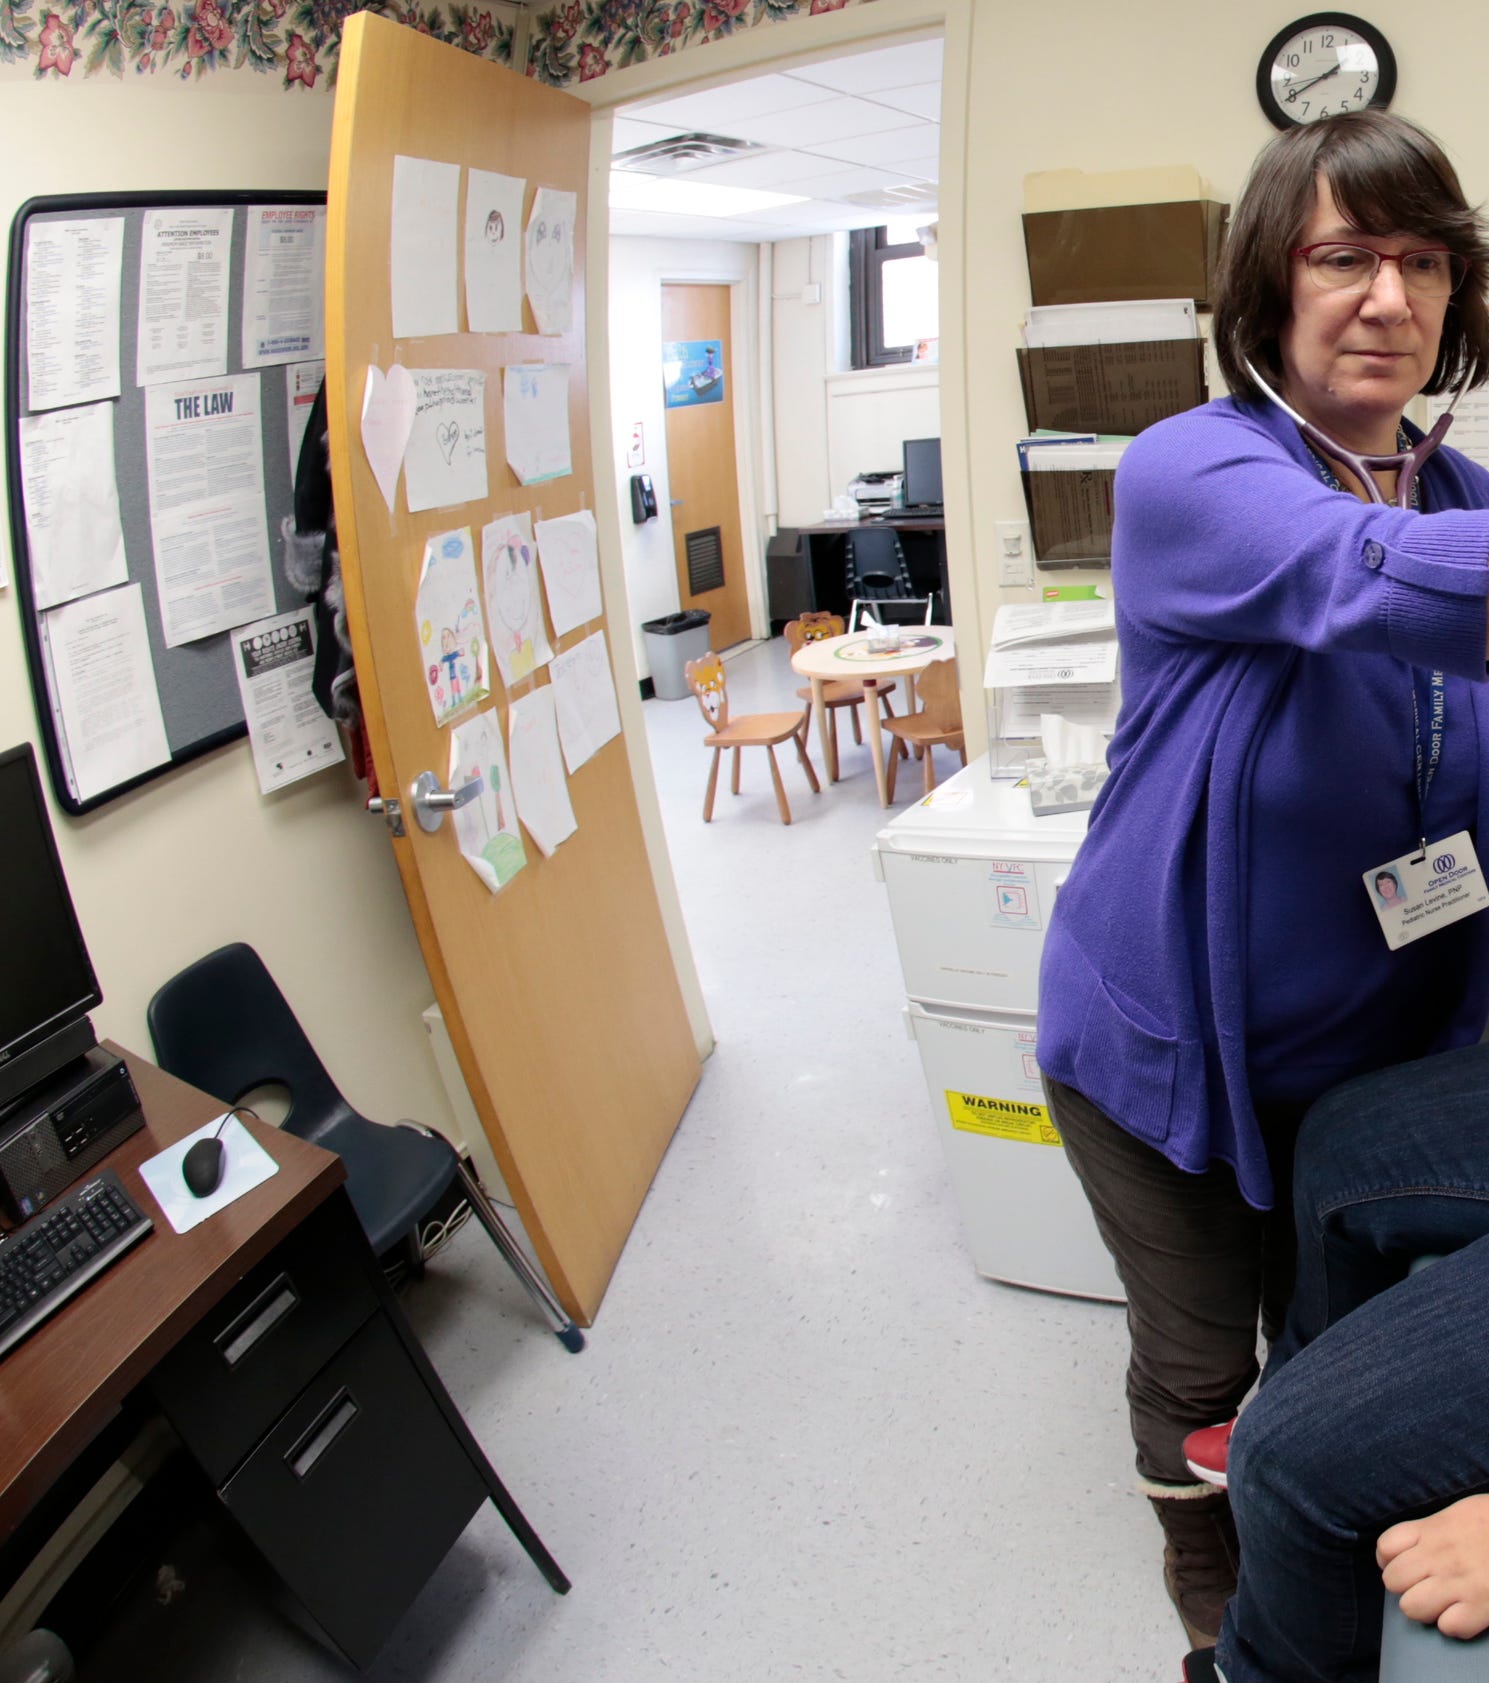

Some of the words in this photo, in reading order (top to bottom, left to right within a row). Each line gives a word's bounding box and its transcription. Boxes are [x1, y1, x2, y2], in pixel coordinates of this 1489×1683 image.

[1303, 40, 1313, 54] 11
[1321, 35, 1334, 48] 12
[1287, 54, 1300, 67] 10
[1360, 70, 1369, 83] 3
[1353, 87, 1364, 101] 4
[1301, 102, 1311, 116] 7
[1340, 100, 1349, 112] 5
[174, 395, 200, 420] THE
[204, 392, 234, 416] LAW
[1431, 690, 1444, 730] FAMILY
[1429, 733, 1442, 765] DOOR
[1428, 876, 1448, 887] OPEN
[1448, 866, 1468, 878] DOOR
[1403, 902, 1425, 915] Susan
[961, 1094, 1042, 1117] WARNING
